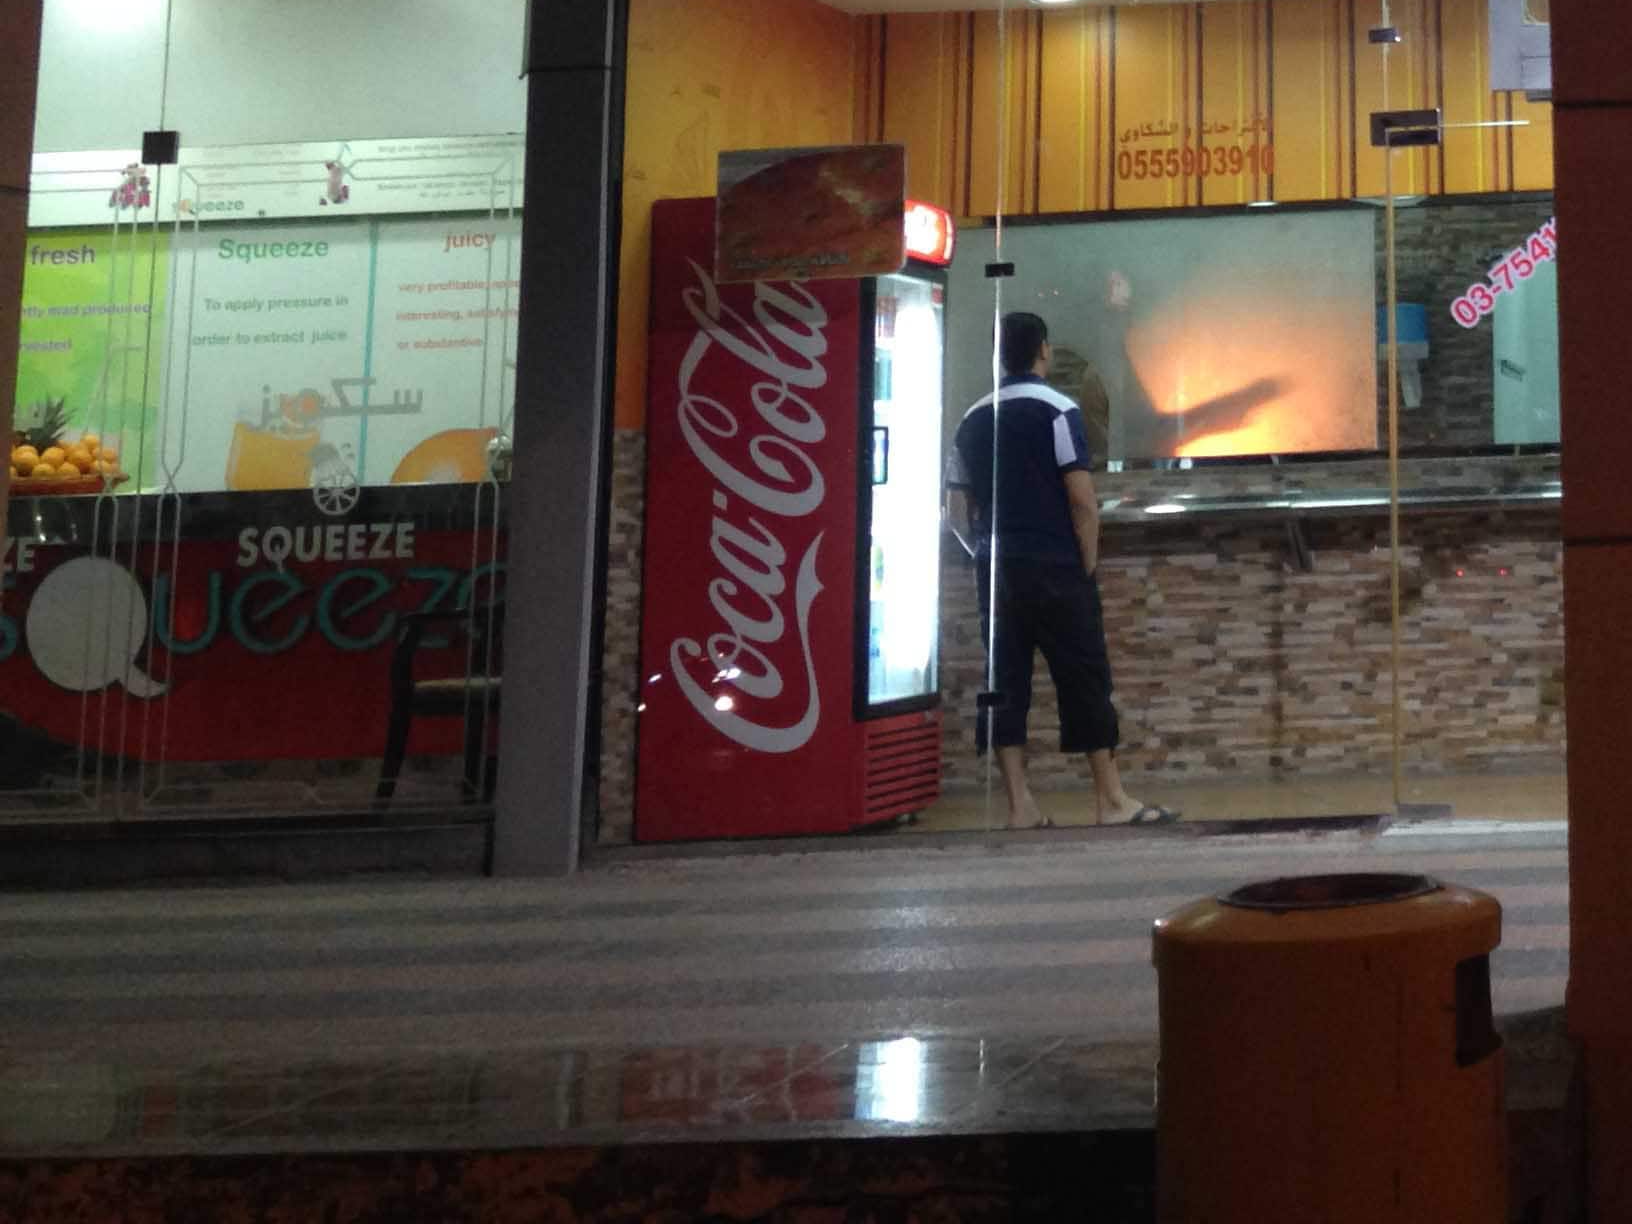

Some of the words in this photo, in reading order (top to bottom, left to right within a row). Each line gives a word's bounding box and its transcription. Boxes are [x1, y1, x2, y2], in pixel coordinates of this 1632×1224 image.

[1118, 144, 1274, 180] 0555903910
[217, 238, 329, 263] Squeeze
[443, 231, 496, 253] juicy
[31, 245, 96, 265] fresh
[204, 298, 221, 310] To
[224, 298, 264, 312] apply
[267, 297, 332, 311] pressure
[233, 332, 249, 345] to
[669, 256, 829, 755] Coca-Cola
[236, 522, 416, 576] SQUEEZE
